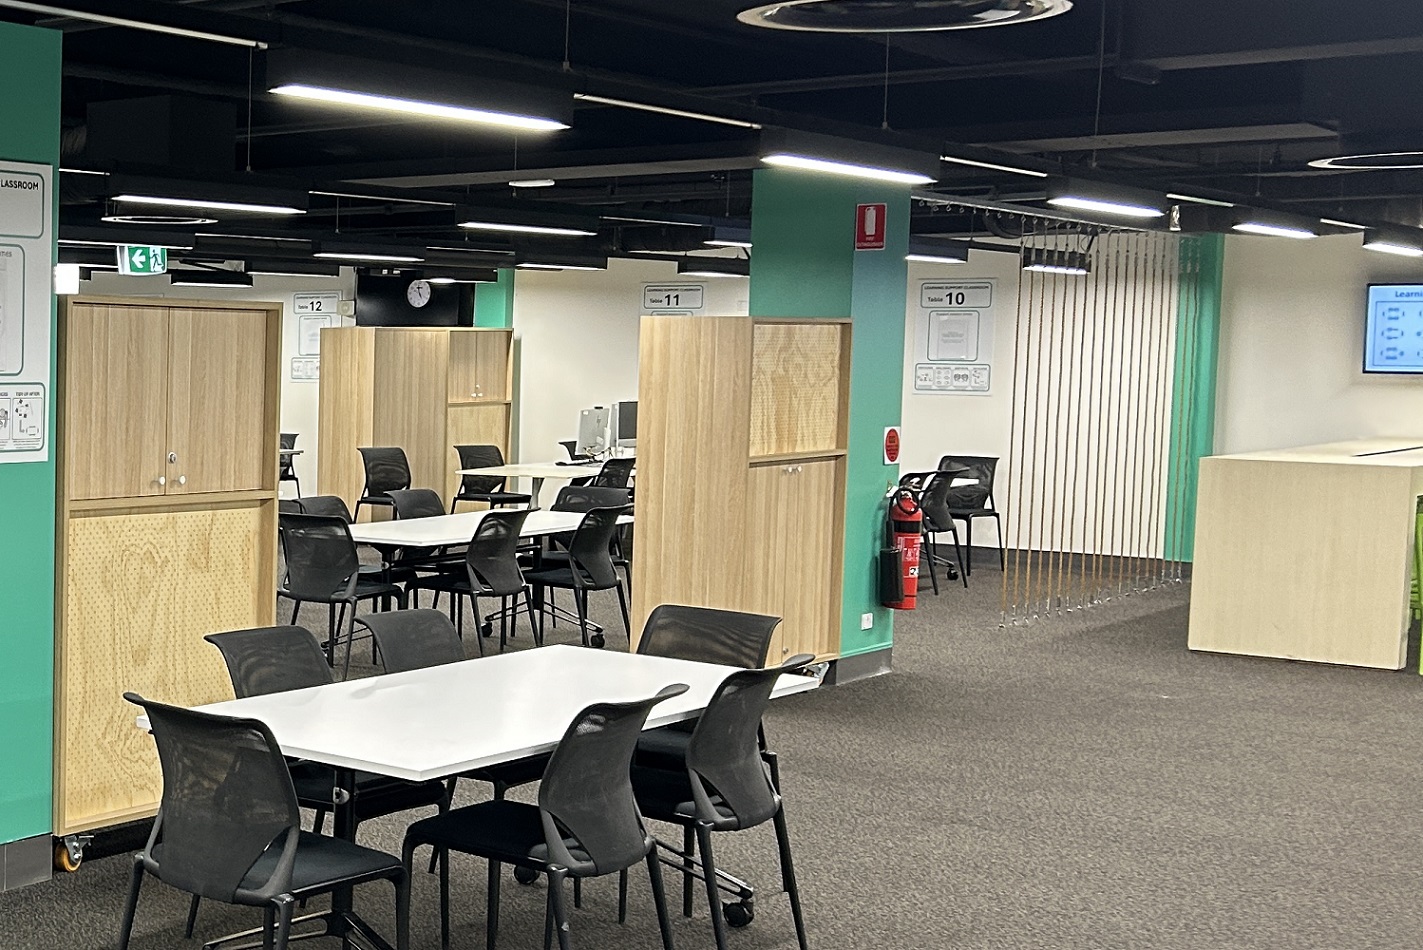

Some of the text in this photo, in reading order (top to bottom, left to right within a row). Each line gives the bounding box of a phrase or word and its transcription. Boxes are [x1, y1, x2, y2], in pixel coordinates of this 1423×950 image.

[665, 294, 679, 306] 11
[945, 292, 965, 305] 10
[309, 301, 322, 312] 12
